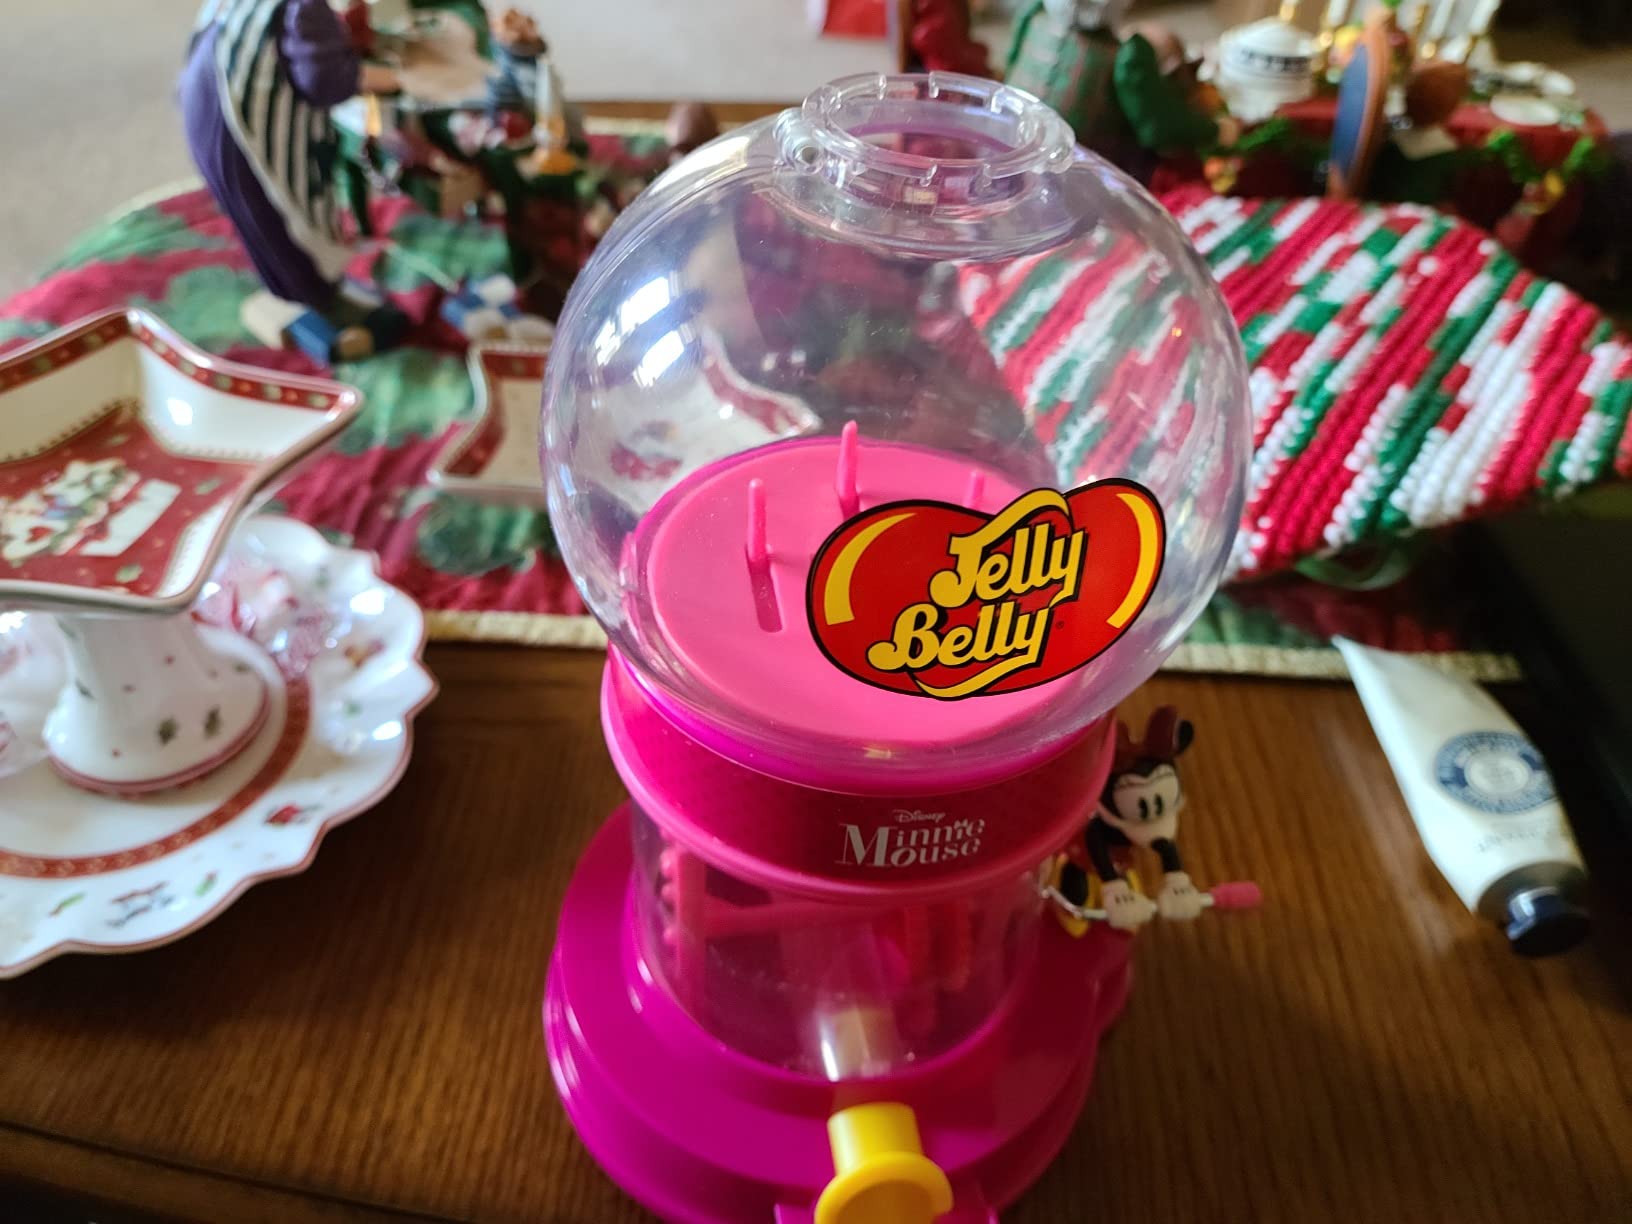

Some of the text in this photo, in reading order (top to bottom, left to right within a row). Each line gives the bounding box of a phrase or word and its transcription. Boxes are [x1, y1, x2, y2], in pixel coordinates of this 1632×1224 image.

[929, 488, 1086, 608] Jelly
[866, 600, 1051, 699] Belly
[834, 818, 985, 868] Minnie
